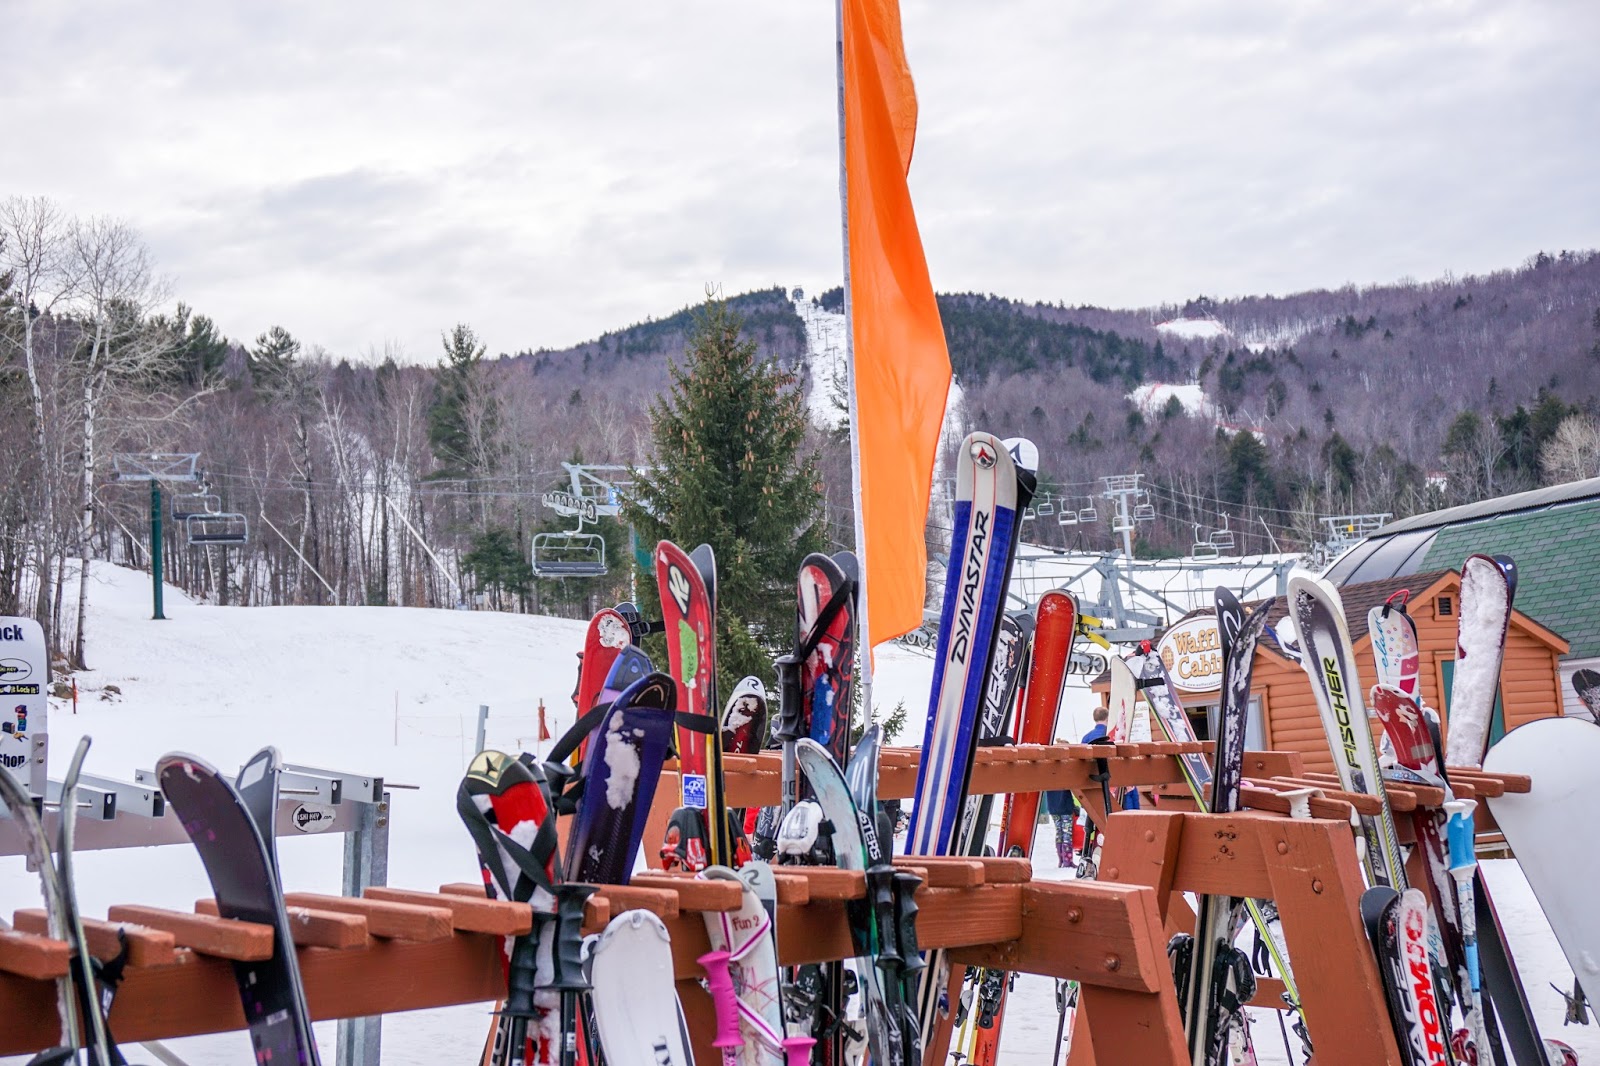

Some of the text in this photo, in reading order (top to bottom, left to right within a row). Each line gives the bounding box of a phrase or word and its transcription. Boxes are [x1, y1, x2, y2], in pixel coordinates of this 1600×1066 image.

[669, 565, 690, 615] K2
[951, 511, 989, 665] DYNASTAR
[1173, 628, 1220, 655] Waffl
[1323, 657, 1361, 770] FISCHER
[1390, 957, 1428, 1066] ACE
[1405, 908, 1446, 1066] TOMIC
